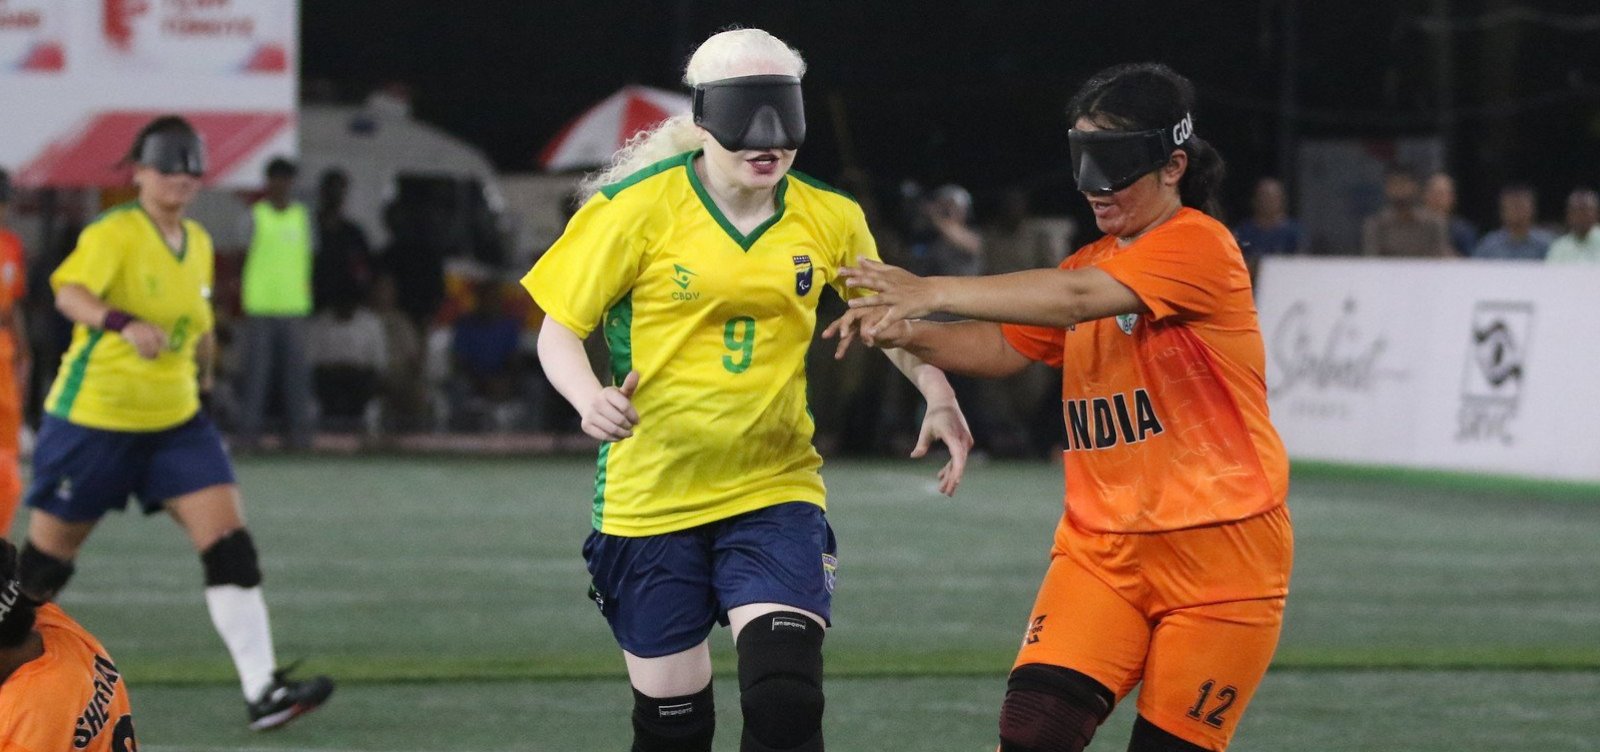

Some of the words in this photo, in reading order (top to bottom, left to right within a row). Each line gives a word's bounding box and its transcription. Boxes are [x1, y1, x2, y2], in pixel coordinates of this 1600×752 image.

[671, 291, 700, 301] CBDV
[722, 315, 756, 374] 9
[1186, 679, 1239, 729] 12
